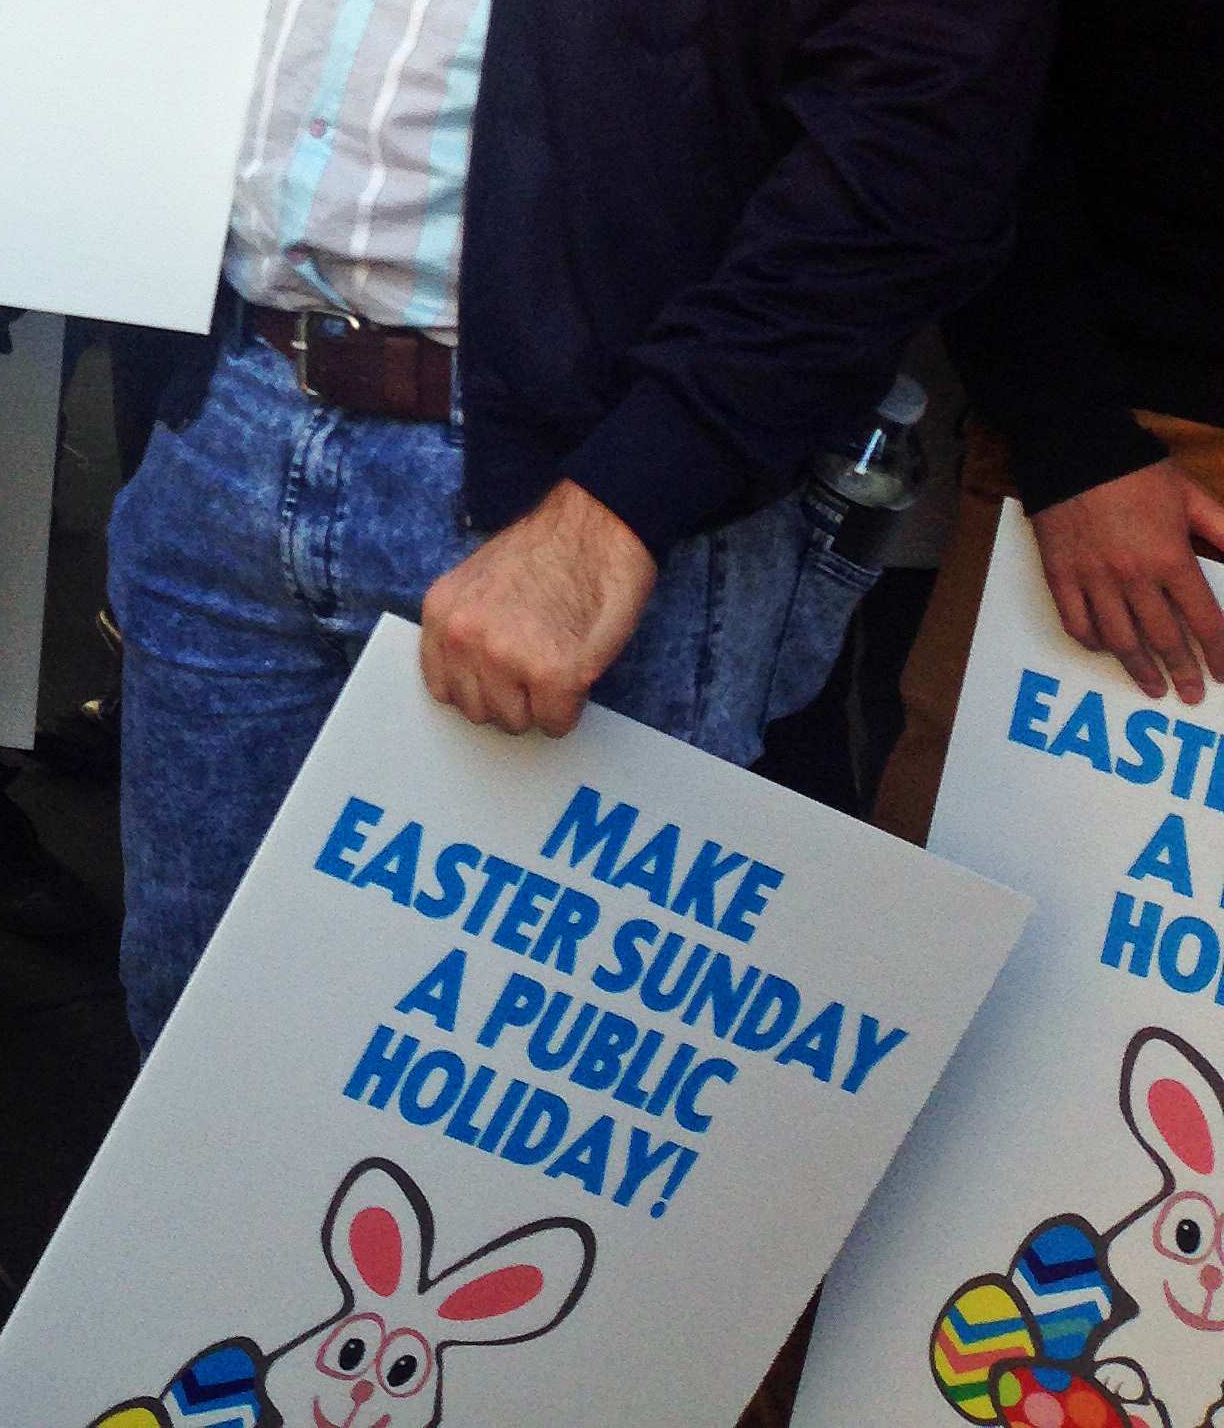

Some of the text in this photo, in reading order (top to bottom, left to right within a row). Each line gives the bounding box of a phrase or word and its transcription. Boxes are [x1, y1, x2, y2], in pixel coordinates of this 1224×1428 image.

[314, 796, 908, 1094] EASTER SUNDAY
[539, 786, 785, 943] MAKE
[1127, 813, 1193, 898] A
[342, 1024, 699, 1219] HOLIDAY!
[395, 948, 738, 1134] A PUBLIC
